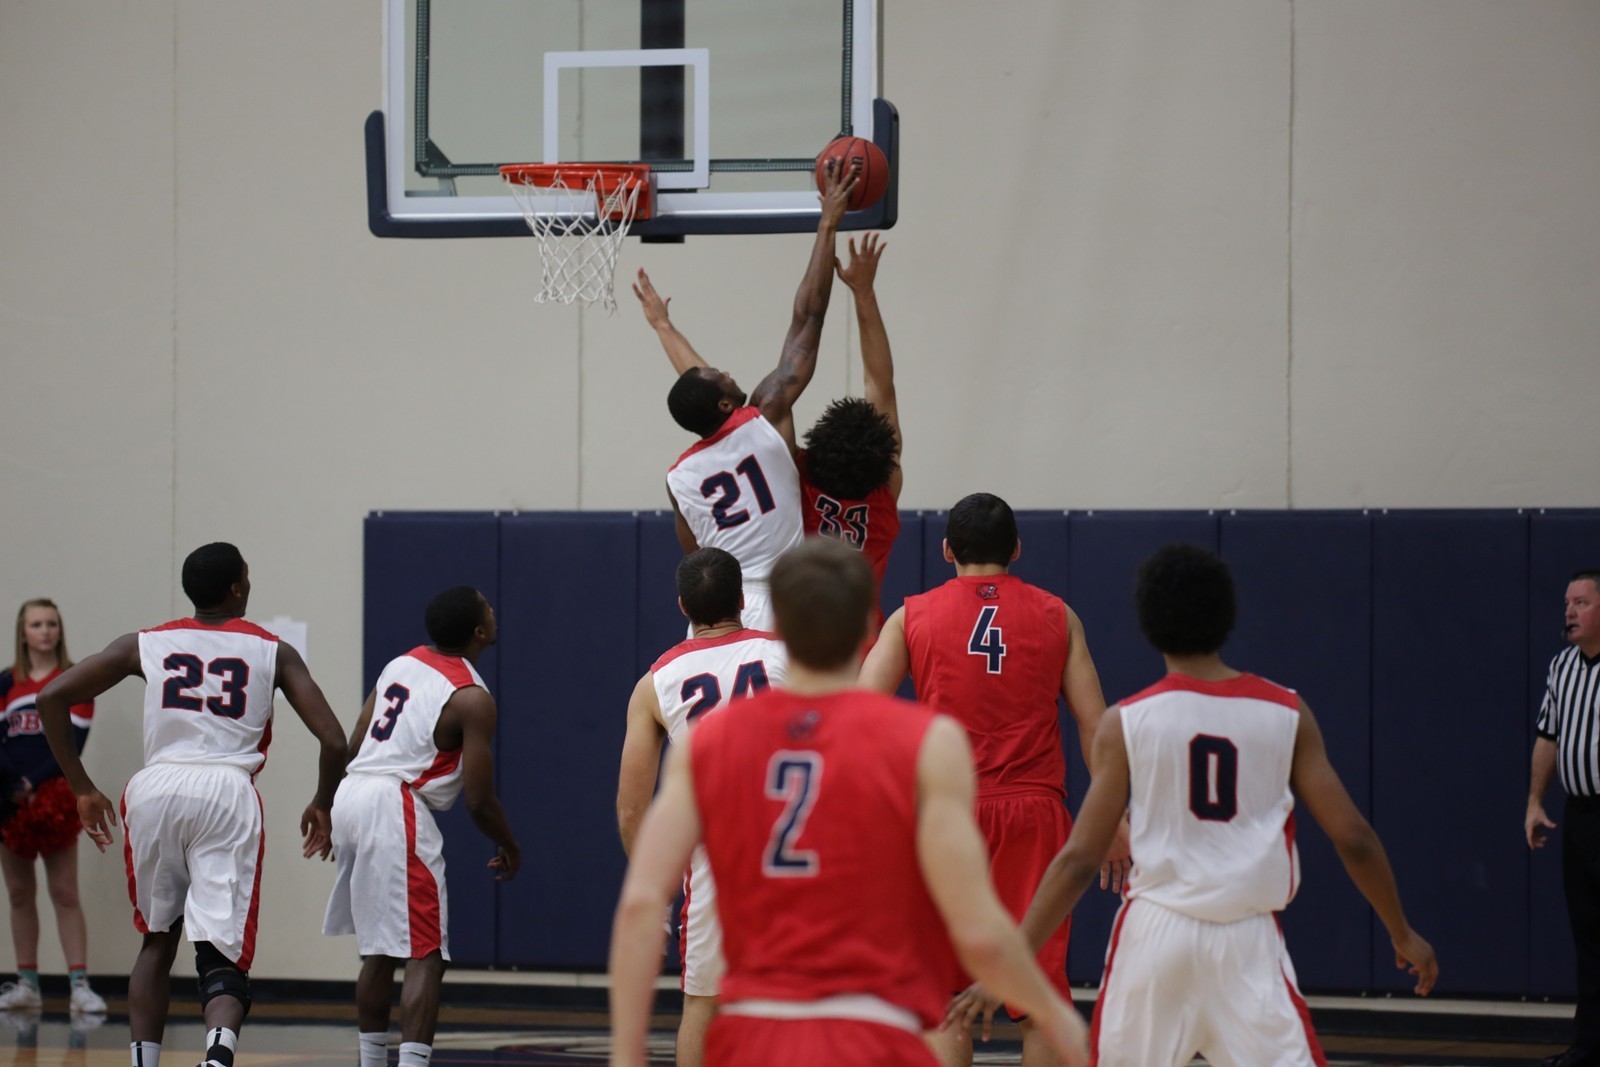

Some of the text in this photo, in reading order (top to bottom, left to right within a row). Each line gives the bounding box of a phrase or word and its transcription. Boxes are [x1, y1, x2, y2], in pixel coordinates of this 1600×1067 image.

[700, 454, 776, 531] 21
[815, 494, 869, 551] 33
[968, 606, 1006, 674] 4
[162, 653, 249, 720] 23
[370, 683, 410, 742] 3
[1189, 733, 1238, 822] 0
[762, 750, 824, 877] 2
